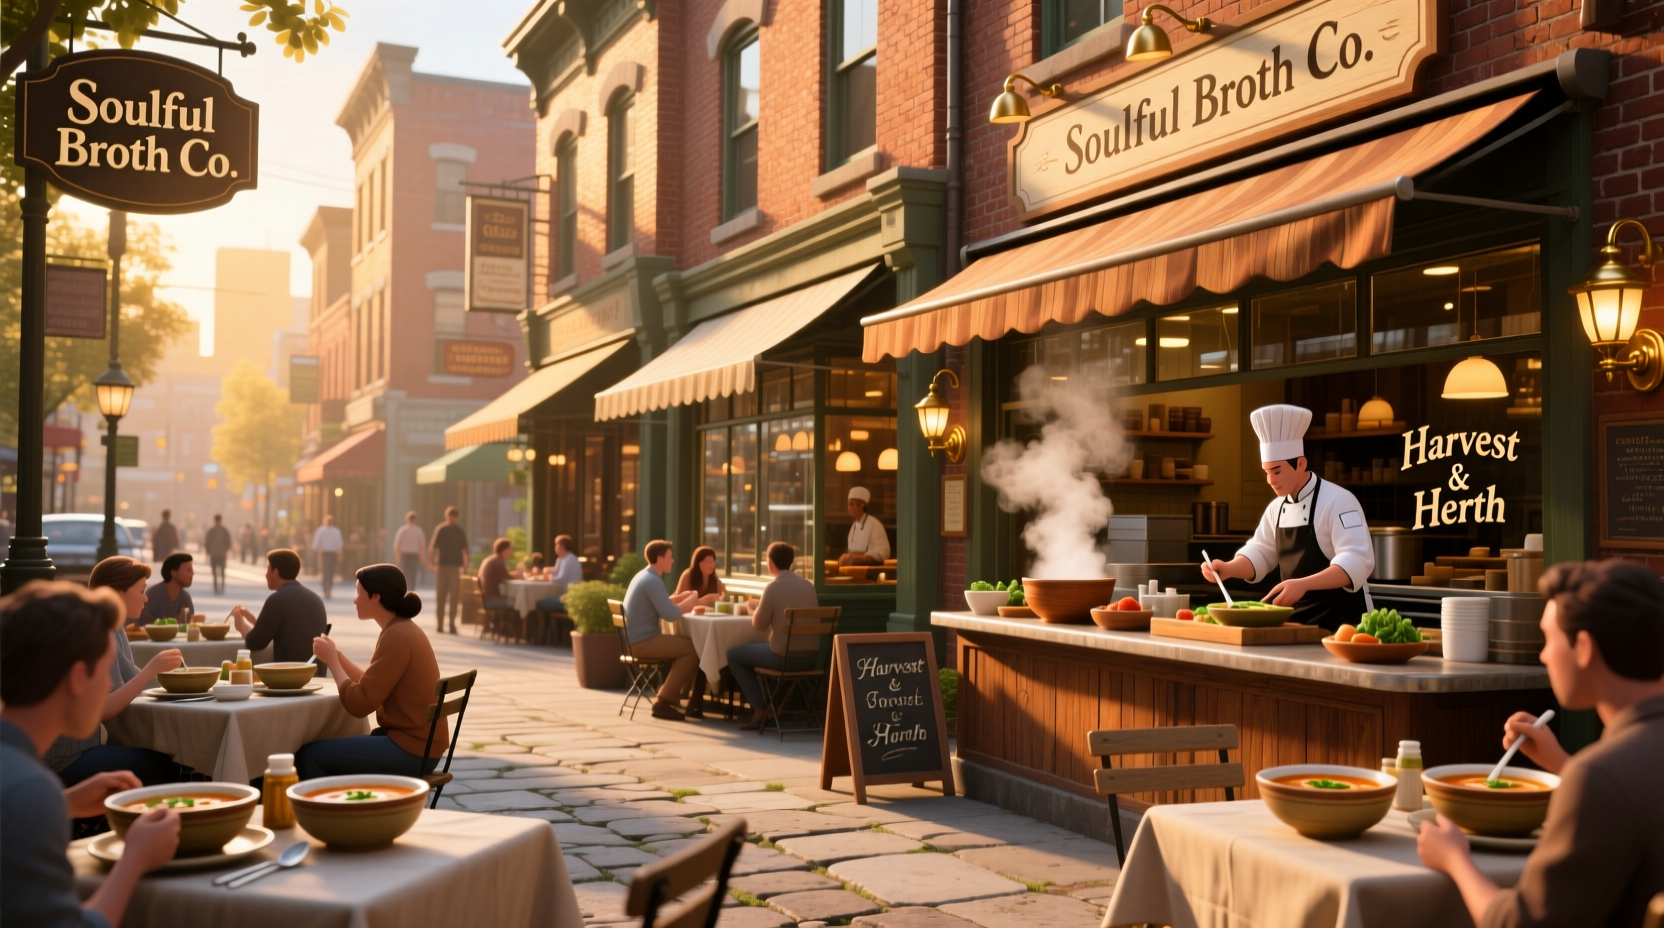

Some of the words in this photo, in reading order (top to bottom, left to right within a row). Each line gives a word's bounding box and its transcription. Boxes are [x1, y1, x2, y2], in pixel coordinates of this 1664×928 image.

[67, 78, 215, 133] Soulful
[1065, 85, 1181, 175] Soulful
[1192, 44, 1294, 127] Broth
[1307, 20, 1374, 80] Co.
[55, 127, 170, 173] Broth
[180, 138, 238, 178] Co.
[1400, 425, 1521, 471] Harvest
[1448, 463, 1470, 491] &
[1411, 484, 1506, 531] Herth
